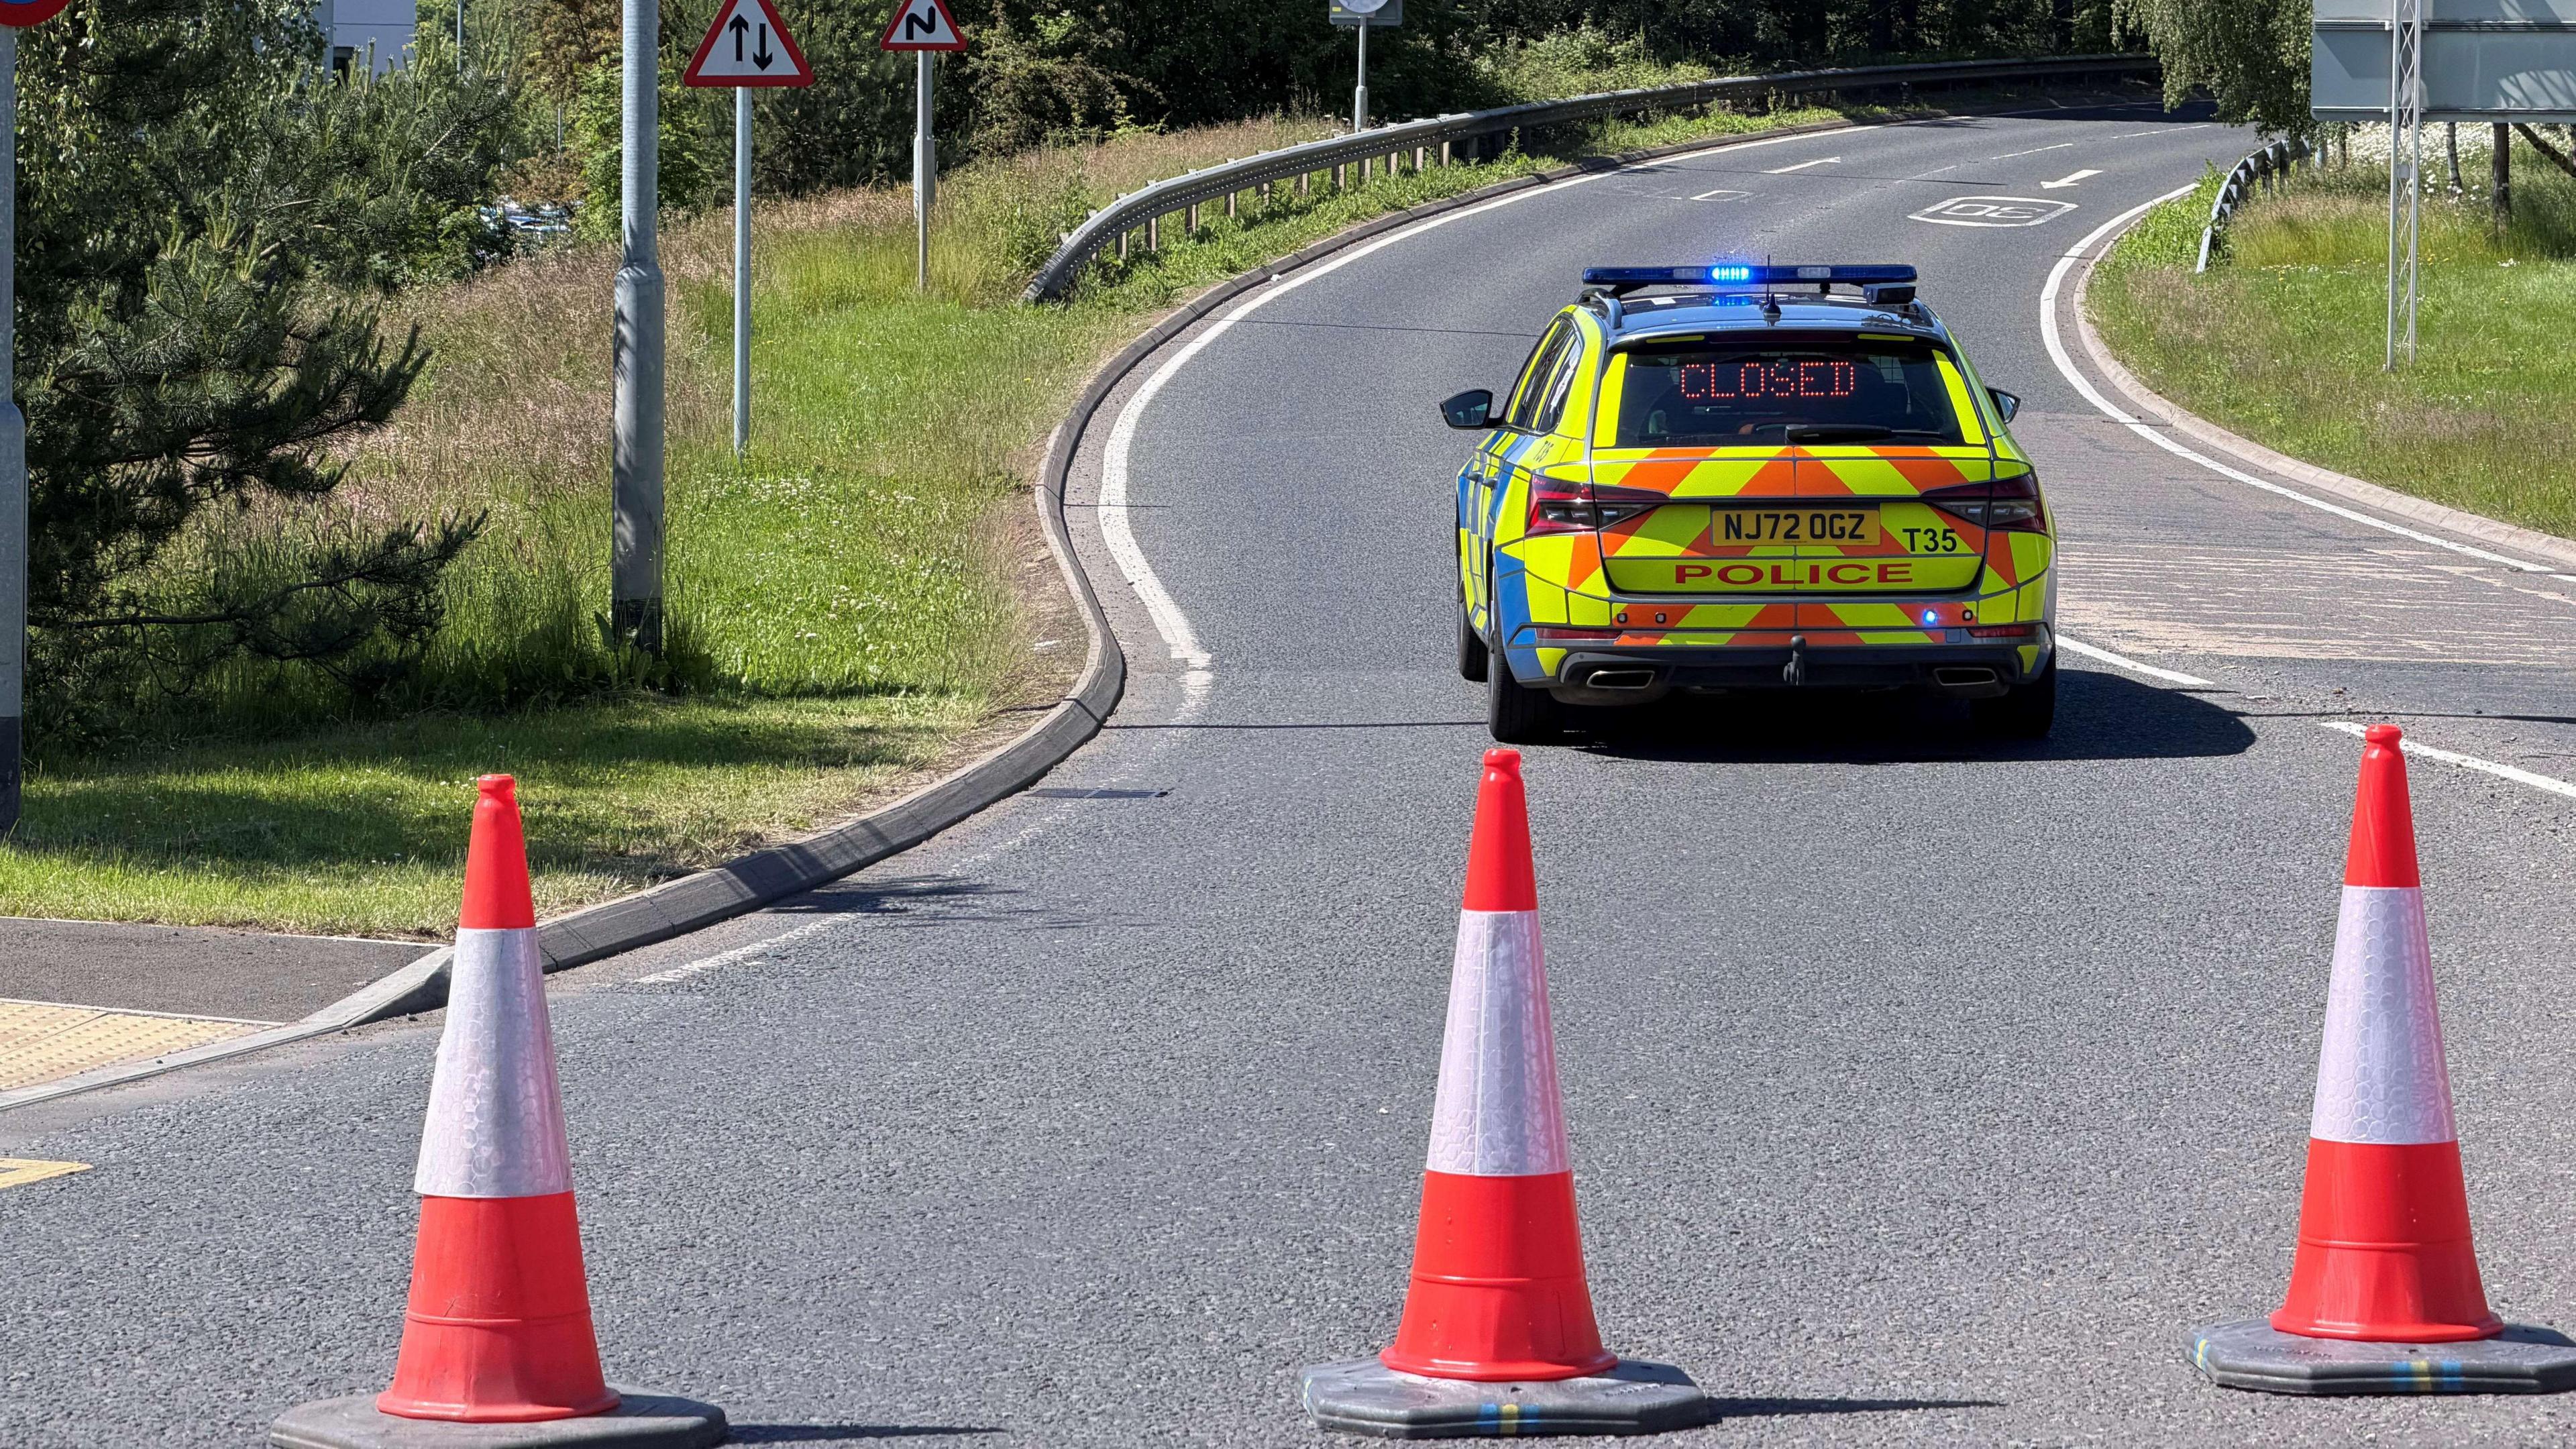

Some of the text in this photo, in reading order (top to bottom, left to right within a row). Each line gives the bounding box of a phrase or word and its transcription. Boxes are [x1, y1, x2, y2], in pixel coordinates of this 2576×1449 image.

[1681, 362, 1854, 397] CLOSED
[1725, 513, 1865, 539] NJ72 OGZ
[1902, 528, 1957, 552] T35
[1675, 563, 1913, 585] POLICE
